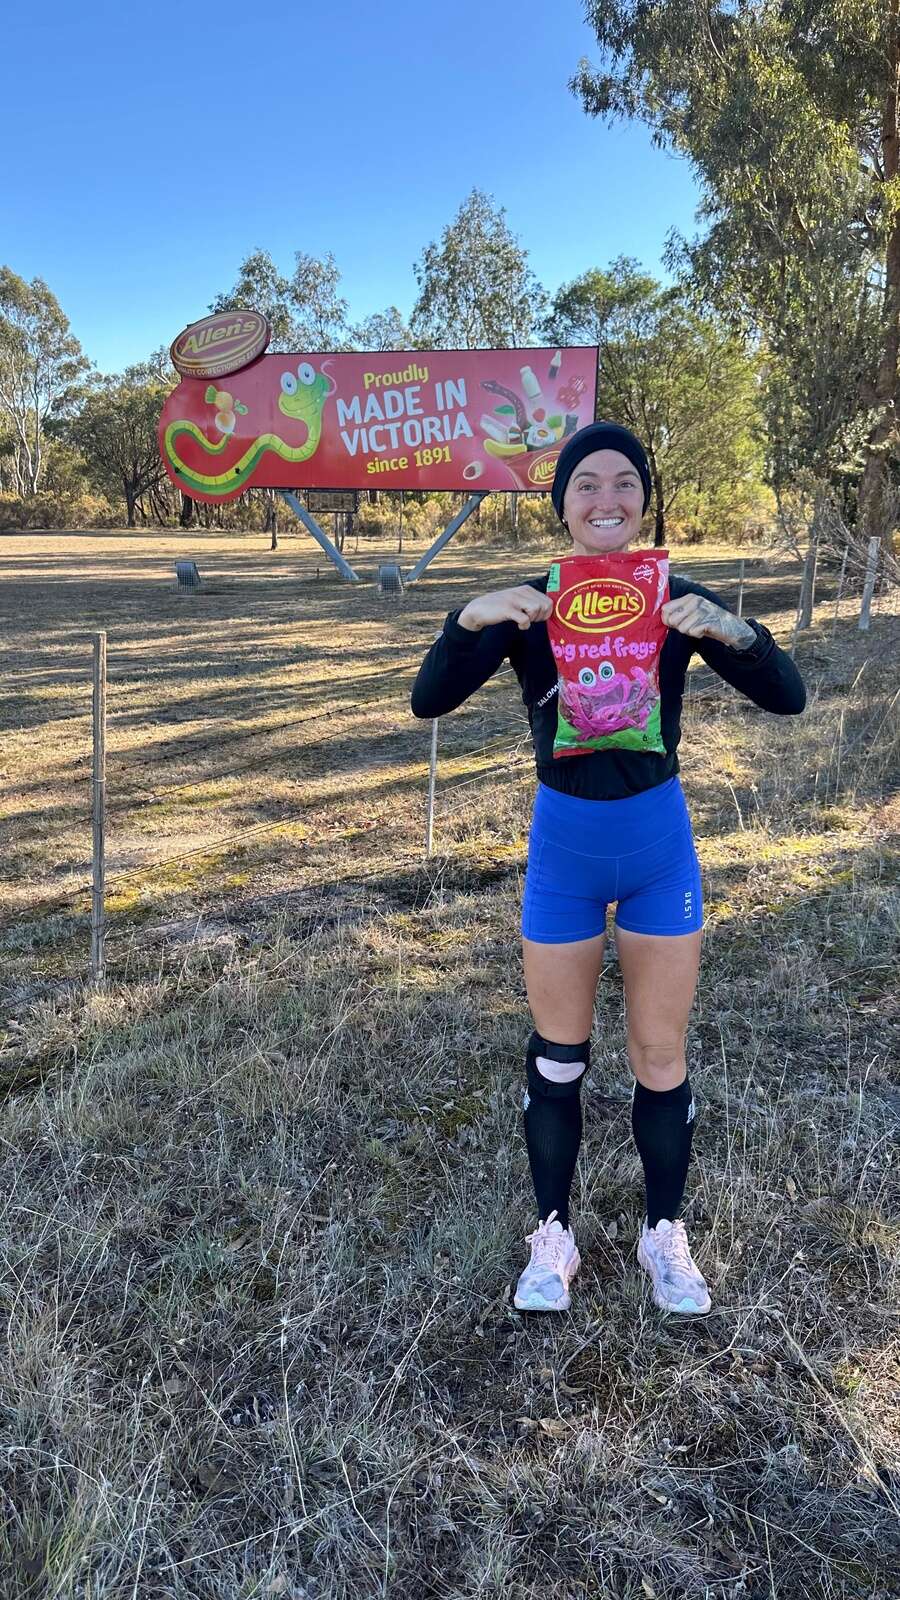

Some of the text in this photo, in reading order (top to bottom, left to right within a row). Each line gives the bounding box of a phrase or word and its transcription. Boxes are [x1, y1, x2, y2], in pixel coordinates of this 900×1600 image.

[180, 318, 257, 355] Allen's
[363, 363, 429, 389] Proudly
[336, 378, 467, 427] MADE IN
[340, 411, 474, 457] VICTORIA
[366, 445, 452, 474] since 1891
[565, 591, 640, 624] Allen's
[551, 635, 657, 662] big red frogs
[537, 682, 562, 707] SALOM
